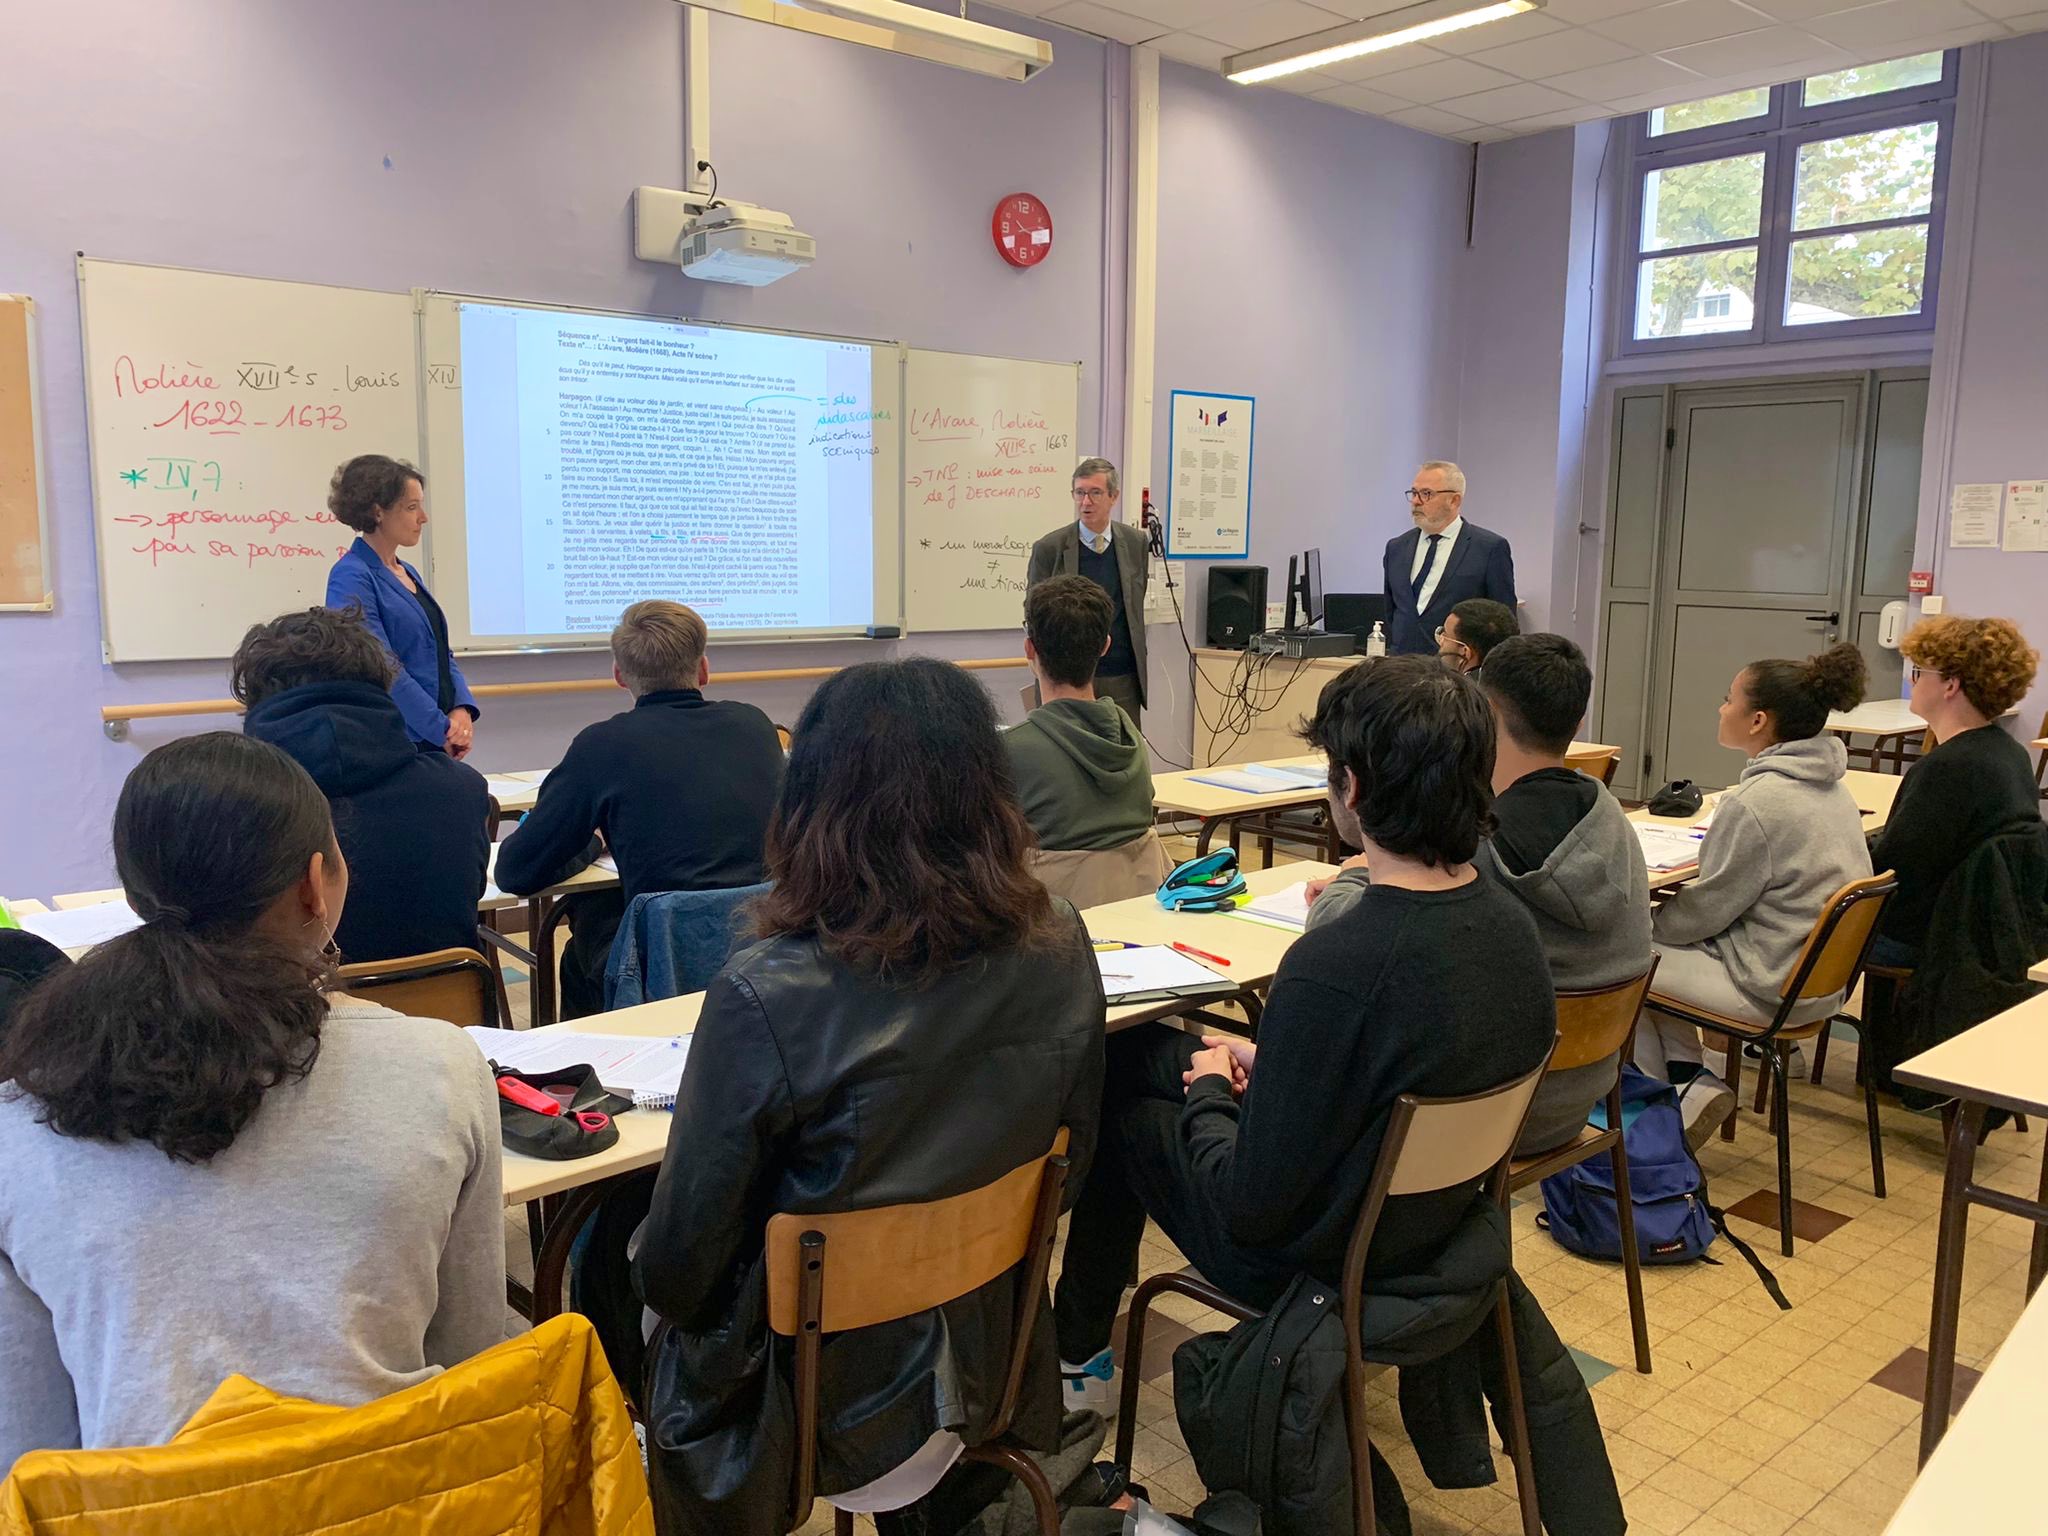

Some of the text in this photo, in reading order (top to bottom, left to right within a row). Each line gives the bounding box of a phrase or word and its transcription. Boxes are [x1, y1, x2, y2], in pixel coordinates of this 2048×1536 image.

[1018, 200, 1030, 214] 12
[1002, 222, 1009, 233] 9
[1020, 247, 1027, 259] 6
[115, 355, 221, 397] Molière
[345, 364, 400, 392] Louis
[427, 364, 461, 389] XIV
[153, 400, 348, 431] 1622 1673
[1046, 434, 1068, 452] 1668
[924, 489, 944, 505] de
[966, 486, 1042, 500] DESCHAMPS
[156, 510, 300, 540] personnage
[208, 540, 238, 556] sa
[247, 543, 326, 568] passion
[940, 535, 1032, 558] un monologu
[960, 574, 1029, 592] une tirad
